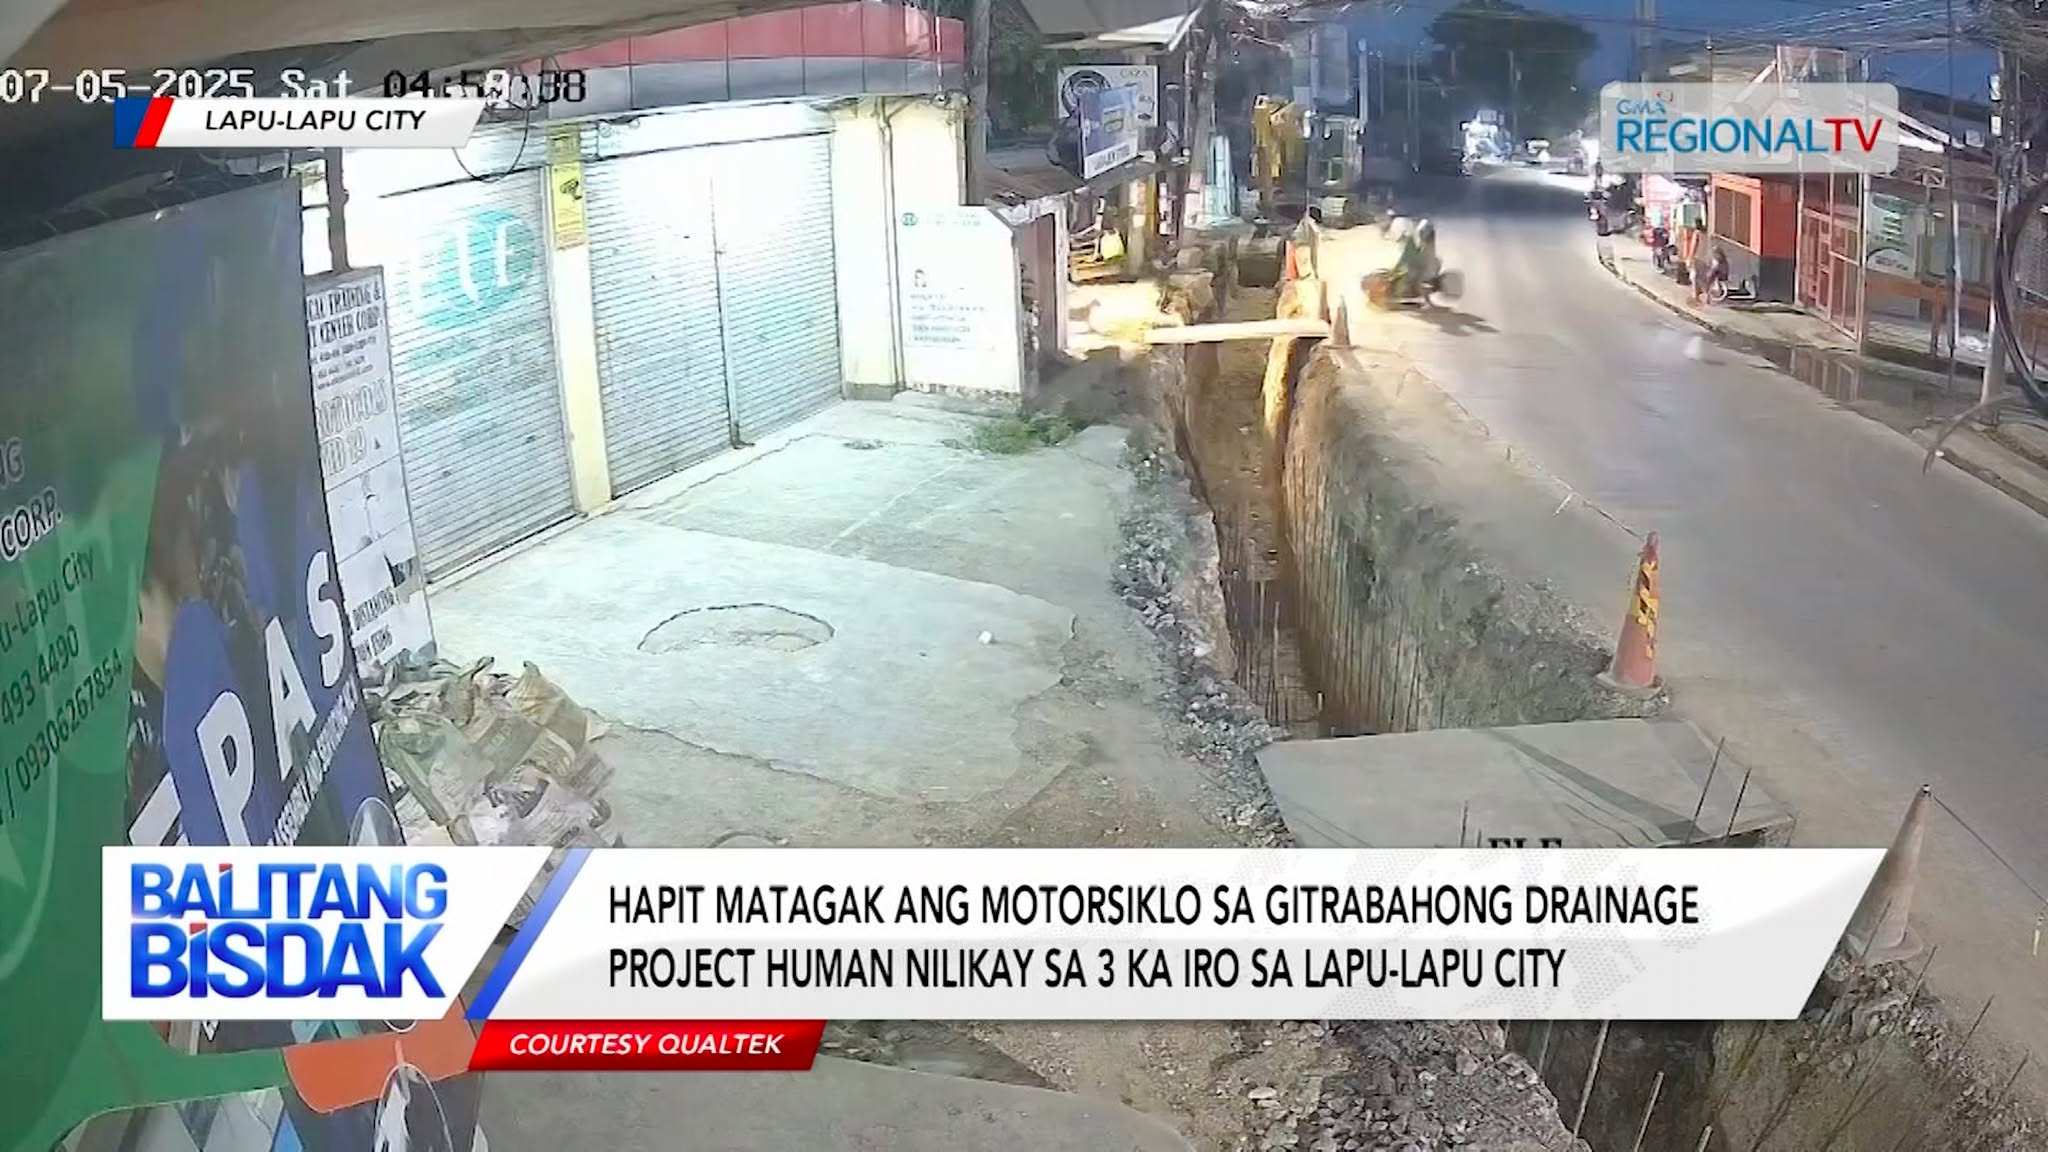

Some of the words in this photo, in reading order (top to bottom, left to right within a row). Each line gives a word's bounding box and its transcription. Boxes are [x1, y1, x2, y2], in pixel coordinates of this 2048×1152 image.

[0, 486, 63, 561] CORP.
[62, 549, 94, 592] City
[38, 624, 79, 686] 4490
